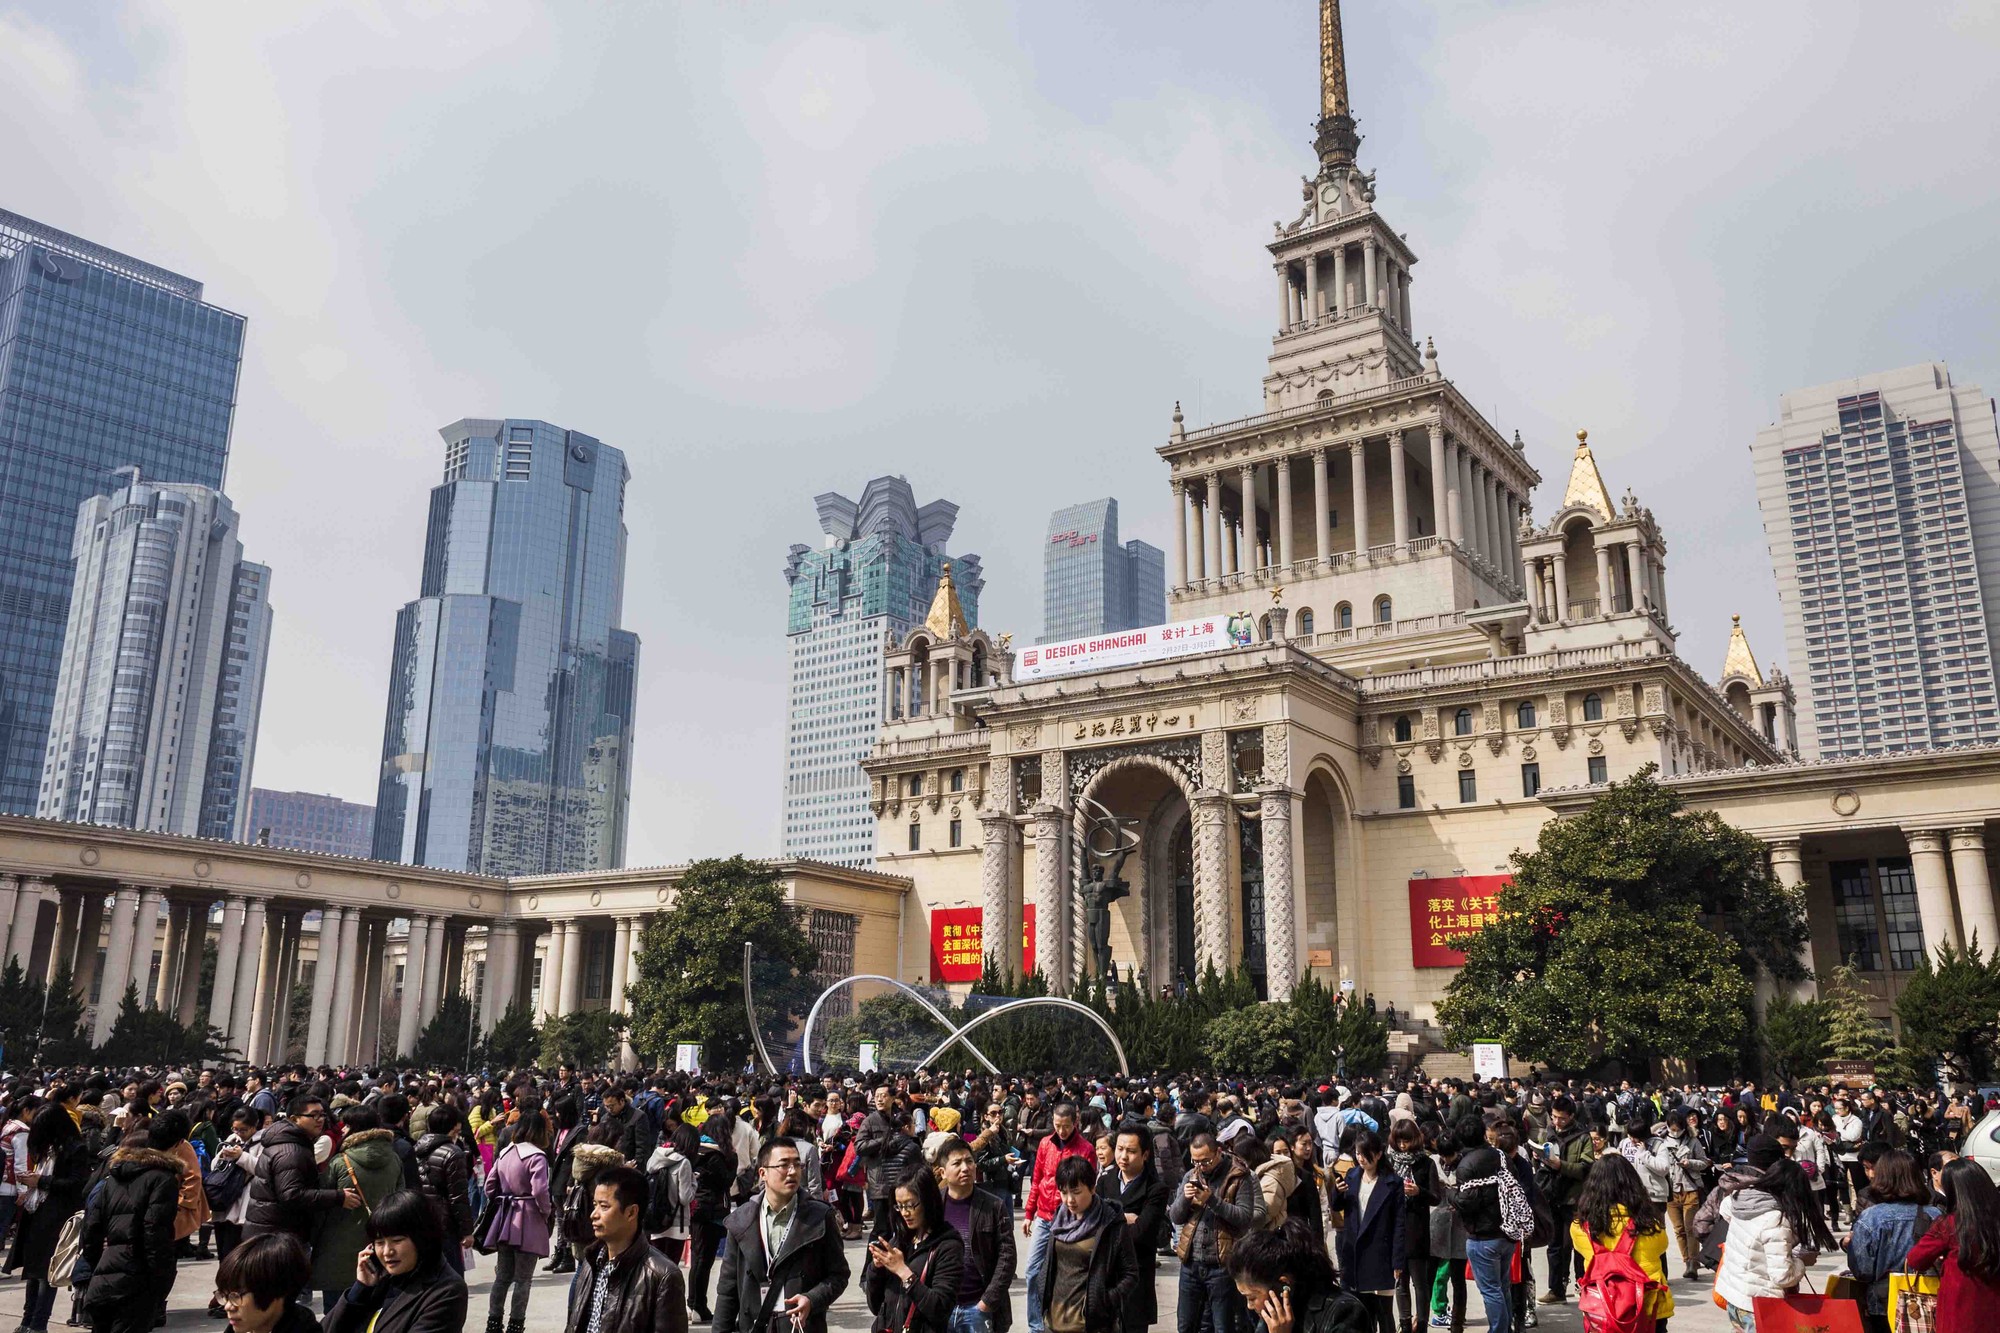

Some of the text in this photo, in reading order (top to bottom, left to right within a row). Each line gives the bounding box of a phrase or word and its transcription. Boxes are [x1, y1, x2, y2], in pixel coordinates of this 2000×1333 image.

[1045, 643, 1086, 660] DESIGN
[1089, 633, 1147, 653] SHANGHAI
[1427, 896, 1500, 913] 落实《关于
[943, 953, 983, 966] 大问题的
